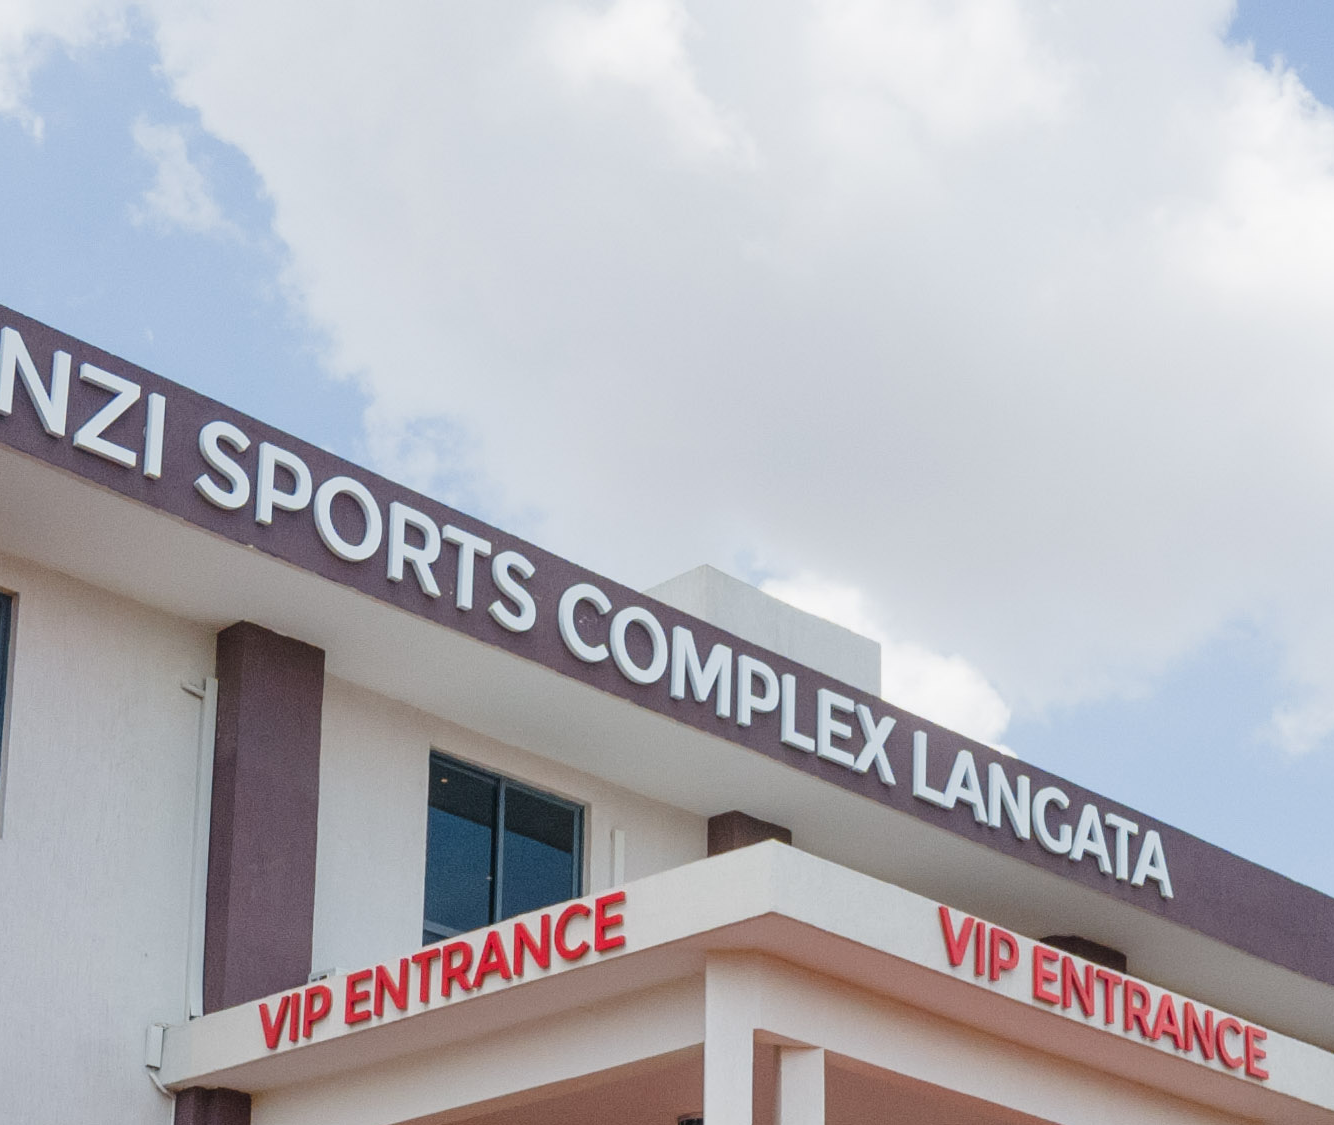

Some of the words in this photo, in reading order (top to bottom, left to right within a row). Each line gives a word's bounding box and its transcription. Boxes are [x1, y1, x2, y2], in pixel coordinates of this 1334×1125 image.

[193, 420, 536, 633] SPORTS
[558, 583, 897, 787] COMPLEX
[912, 730, 1174, 899] LANGATA
[258, 984, 333, 1050] VIP
[343, 890, 627, 1026] ENTRANCE
[937, 905, 1021, 983] VIP
[1031, 944, 1270, 1080] ENTRANCE
